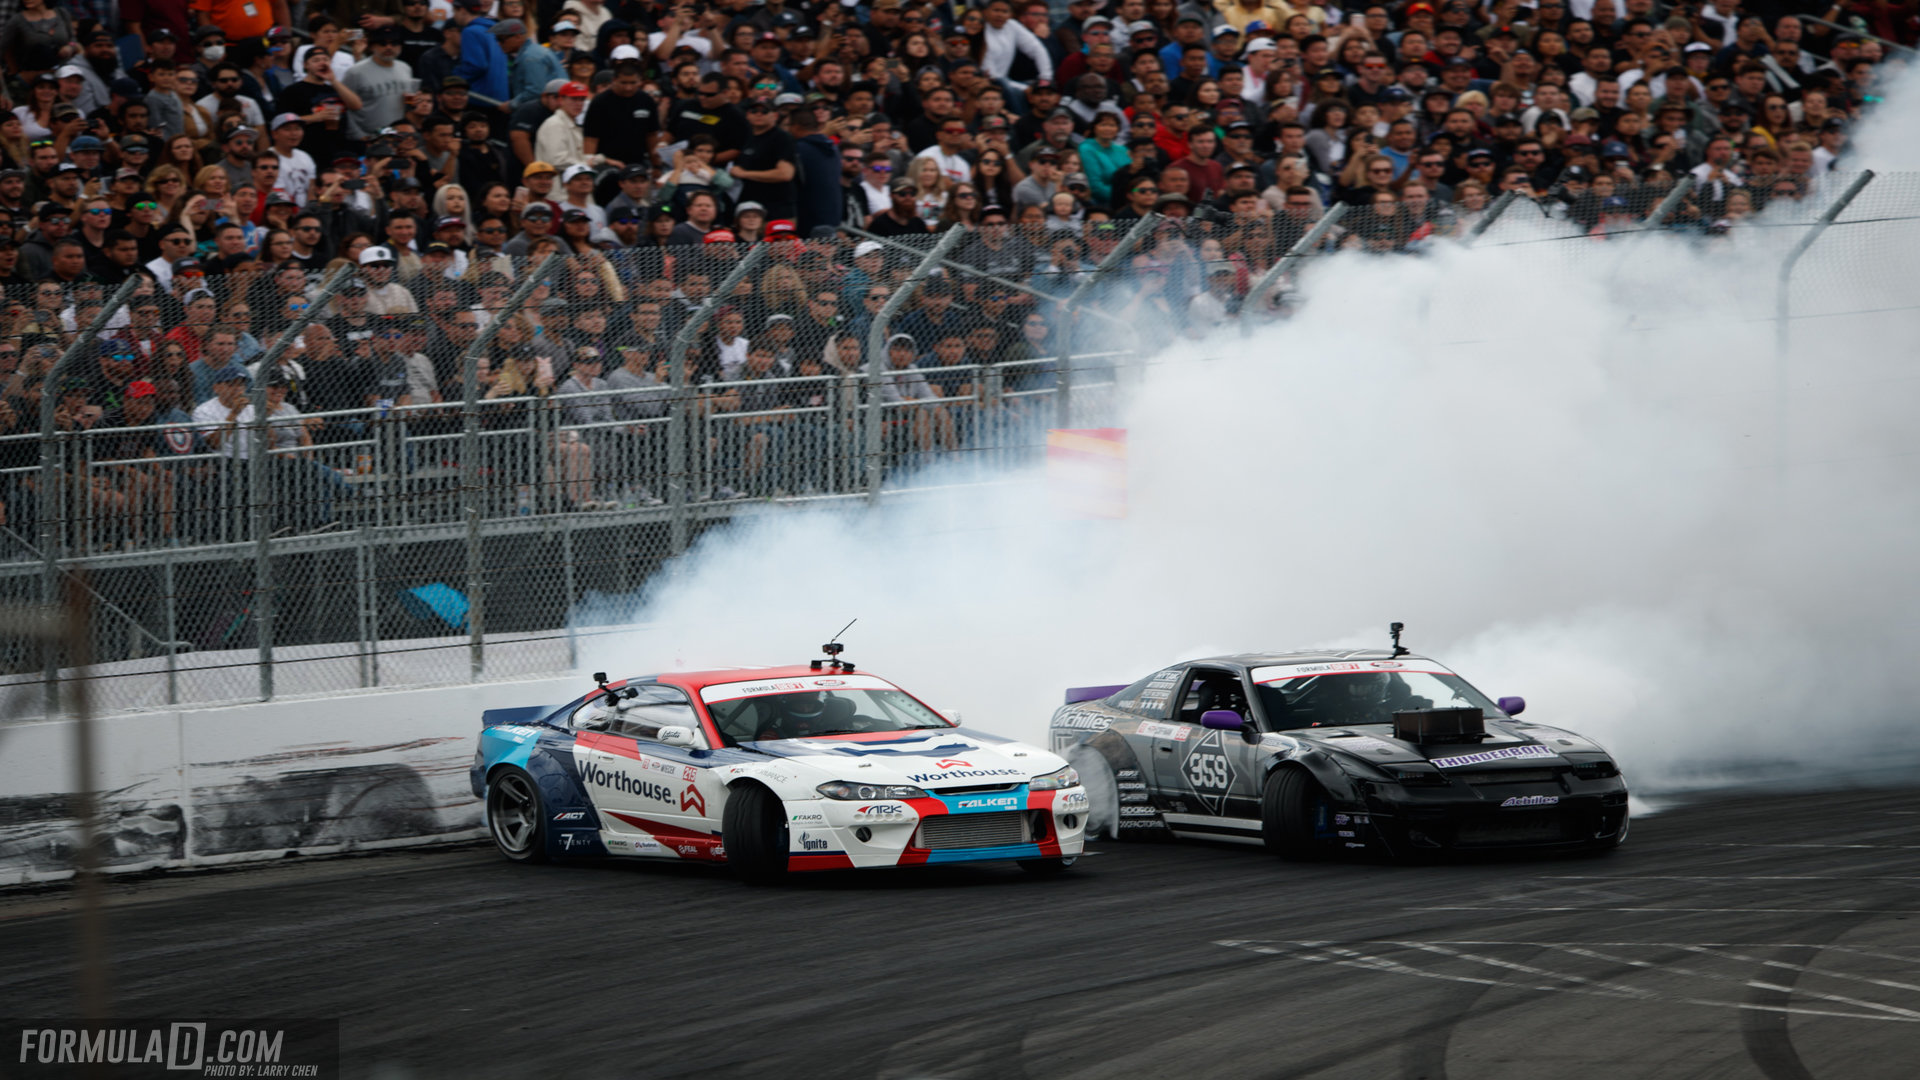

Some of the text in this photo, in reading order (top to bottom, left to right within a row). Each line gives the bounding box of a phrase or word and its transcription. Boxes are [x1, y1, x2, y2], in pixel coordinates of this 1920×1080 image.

[1296, 663, 1331, 673] FORMULA
[742, 685, 775, 694] FORMULA
[1432, 744, 1552, 768] THUNDERBOLT
[683, 766, 697, 782] 215
[907, 769, 1026, 783] Worthouse.
[1189, 752, 1229, 790] 959
[579, 760, 676, 805] Worthouse.
[958, 797, 1018, 808] FALKEN
[1500, 796, 1559, 807] Achilles
[867, 805, 903, 814] ARK
[803, 839, 828, 851] ignite
